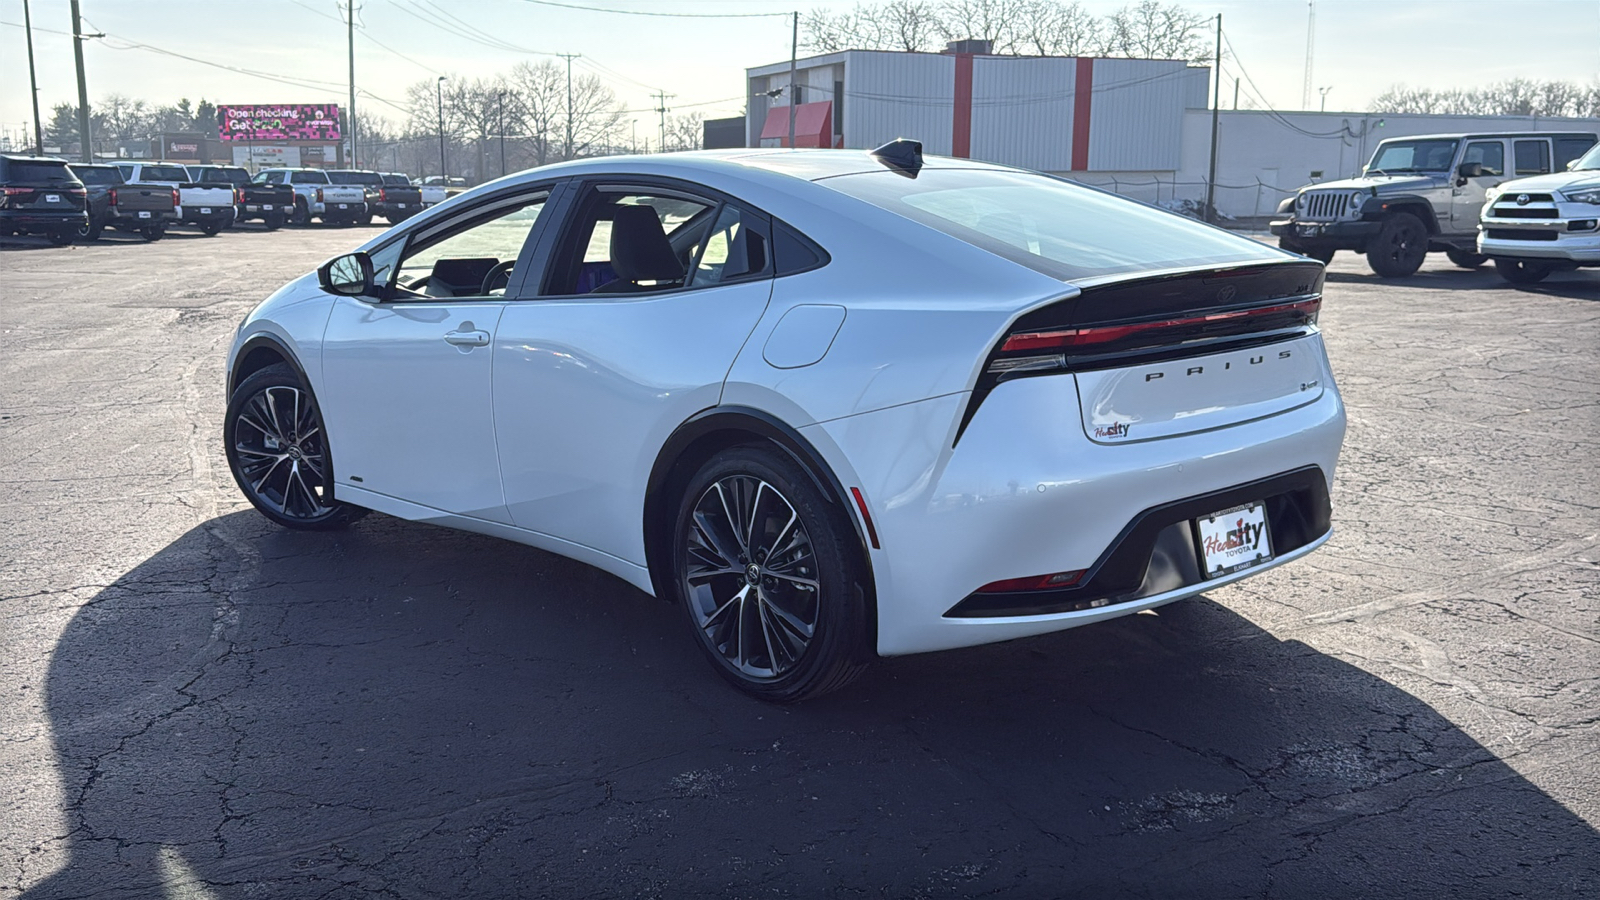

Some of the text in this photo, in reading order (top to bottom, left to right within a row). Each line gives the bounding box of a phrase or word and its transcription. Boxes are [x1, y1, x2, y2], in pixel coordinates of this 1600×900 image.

[228, 109, 254, 119] Open
[229, 120, 250, 130] Get
[1145, 350, 1291, 382] PRIUS
[1204, 518, 1264, 557] Heart city
[1225, 545, 1251, 557] TOYOTA
[1233, 561, 1252, 572] ELKHART
